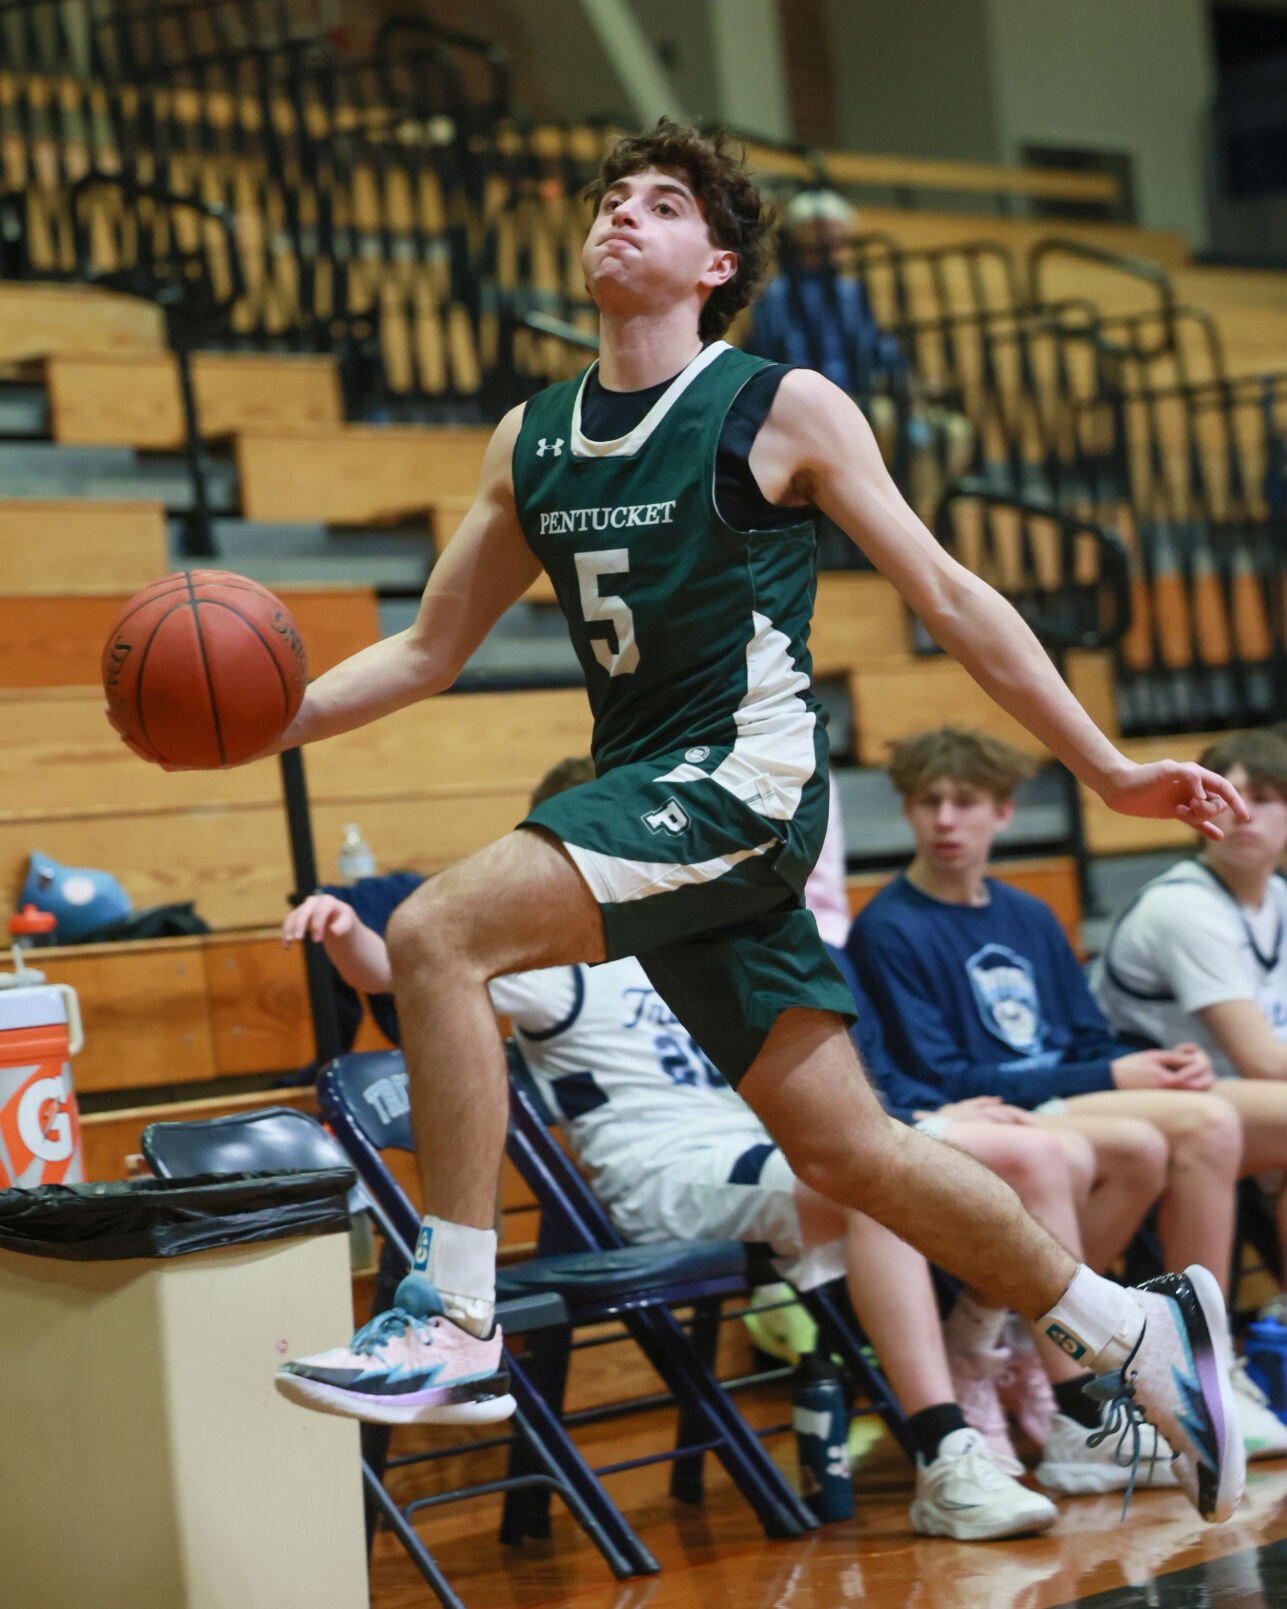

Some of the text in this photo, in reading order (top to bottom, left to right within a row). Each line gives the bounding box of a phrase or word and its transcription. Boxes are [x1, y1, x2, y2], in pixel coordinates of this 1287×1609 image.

[539, 500, 677, 535] PENTUCKET
[574, 548, 641, 677] 5
[641, 796, 691, 837] P
[17, 1074, 73, 1162] G
